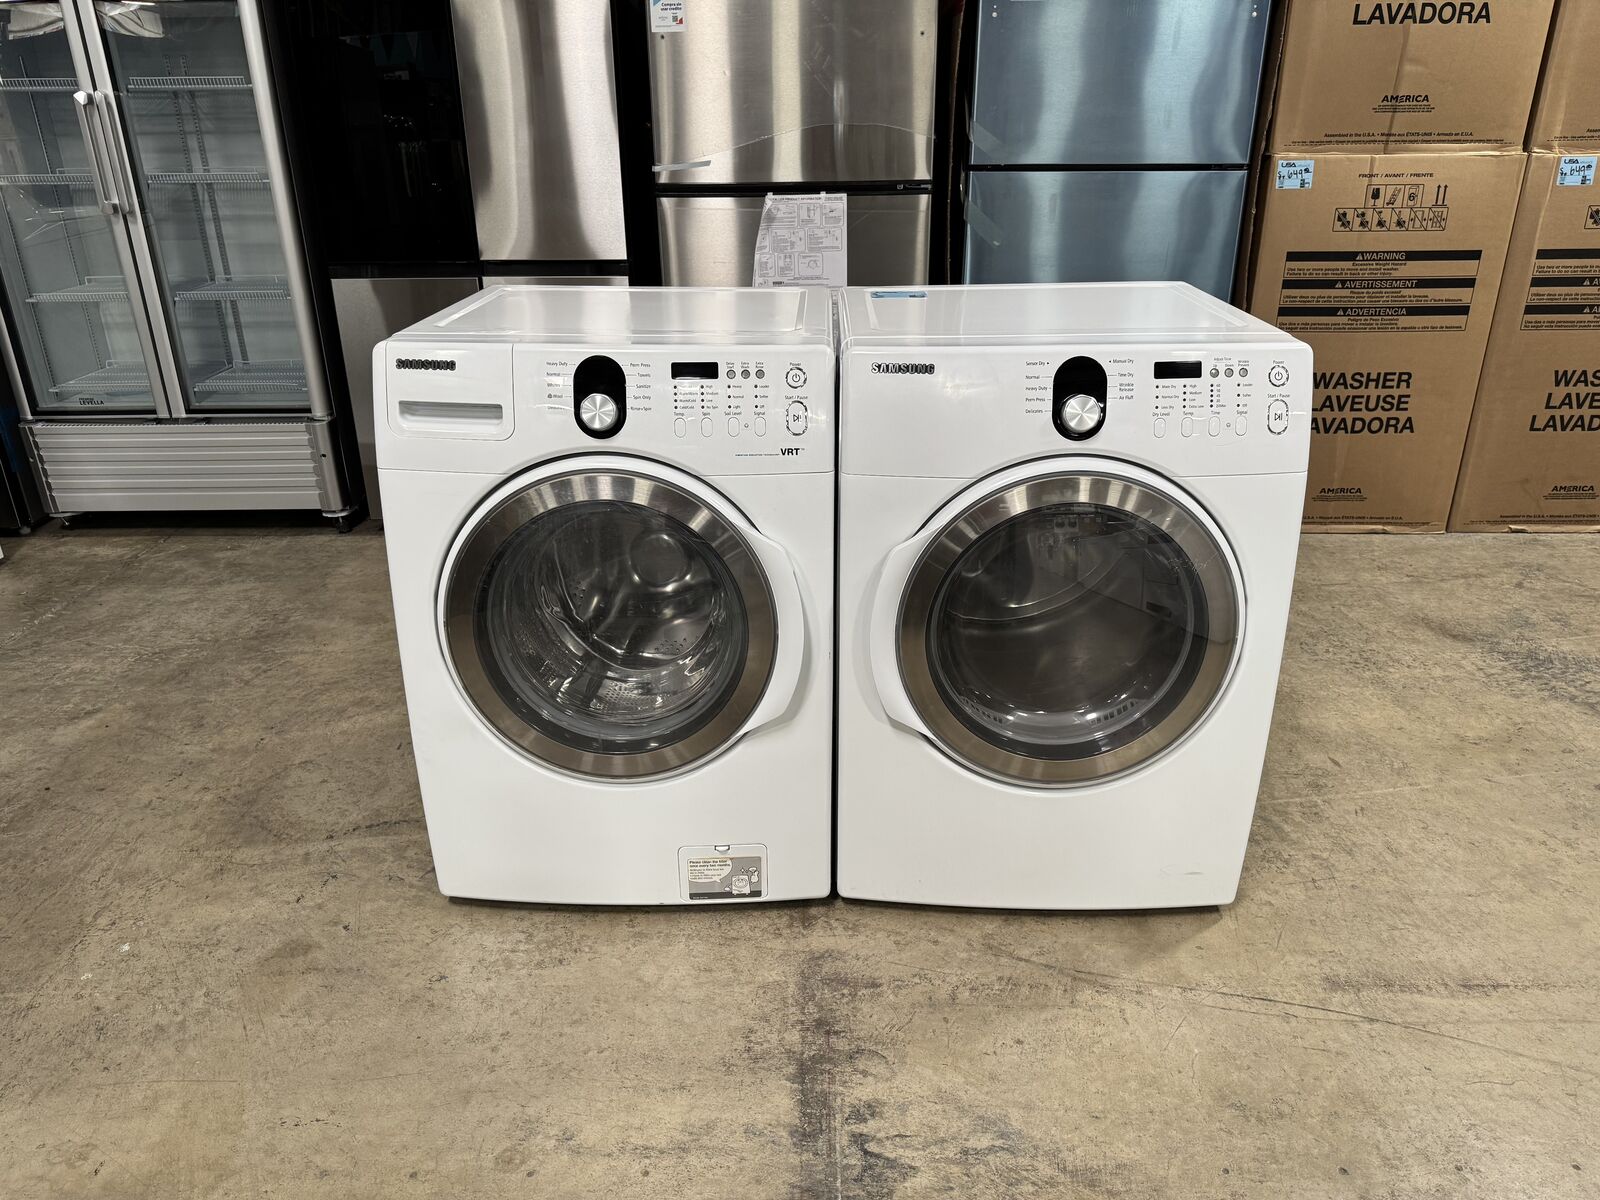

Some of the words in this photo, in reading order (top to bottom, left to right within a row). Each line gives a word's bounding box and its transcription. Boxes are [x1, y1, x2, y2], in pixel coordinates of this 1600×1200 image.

[1352, 2, 1491, 25] LAVADORA
[1381, 94, 1430, 103] AMERICA
[396, 358, 456, 371] SAMSUNG
[871, 362, 935, 374] SAMSUNG
[1313, 372, 1412, 390] WASHER
[1554, 370, 1600, 387] WAS
[1544, 392, 1600, 409] LAVE
[1311, 417, 1414, 434] AVADORA
[1529, 415, 1600, 432] LAVAD
